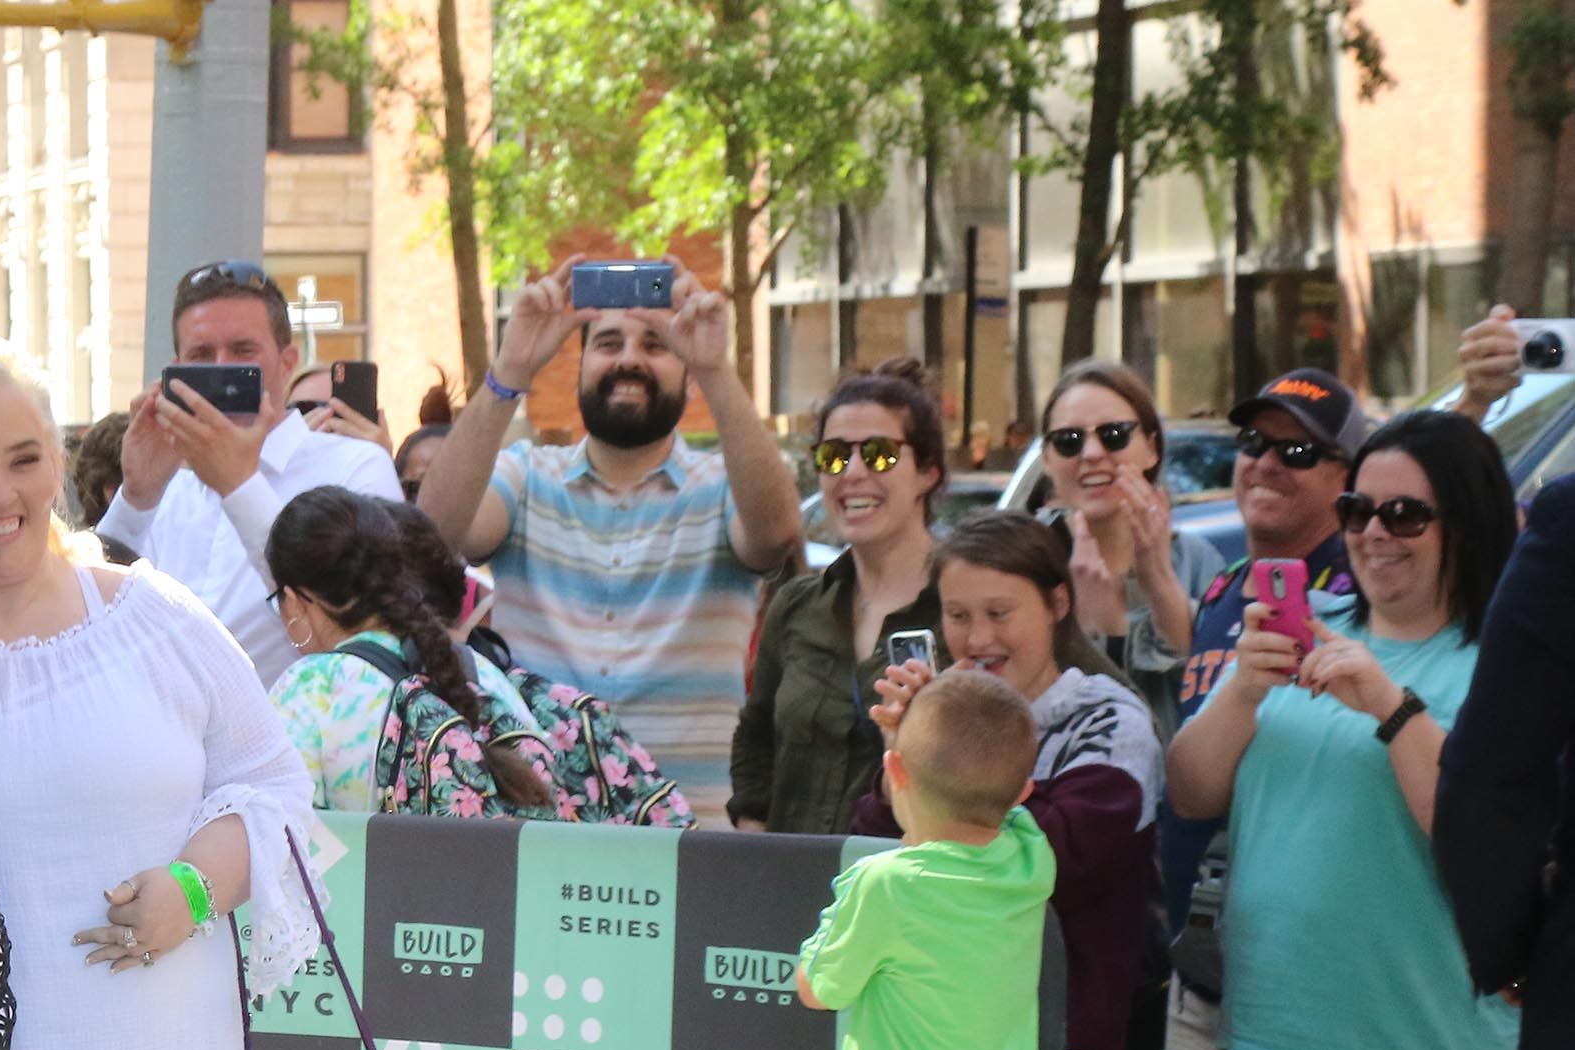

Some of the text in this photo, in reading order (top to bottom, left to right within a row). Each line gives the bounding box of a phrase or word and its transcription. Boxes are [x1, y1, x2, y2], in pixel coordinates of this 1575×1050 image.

[561, 883, 661, 906] #BUILD
[560, 915, 660, 939] SERIES
[403, 930, 476, 958] BUILD
[714, 954, 794, 985] BUILD
